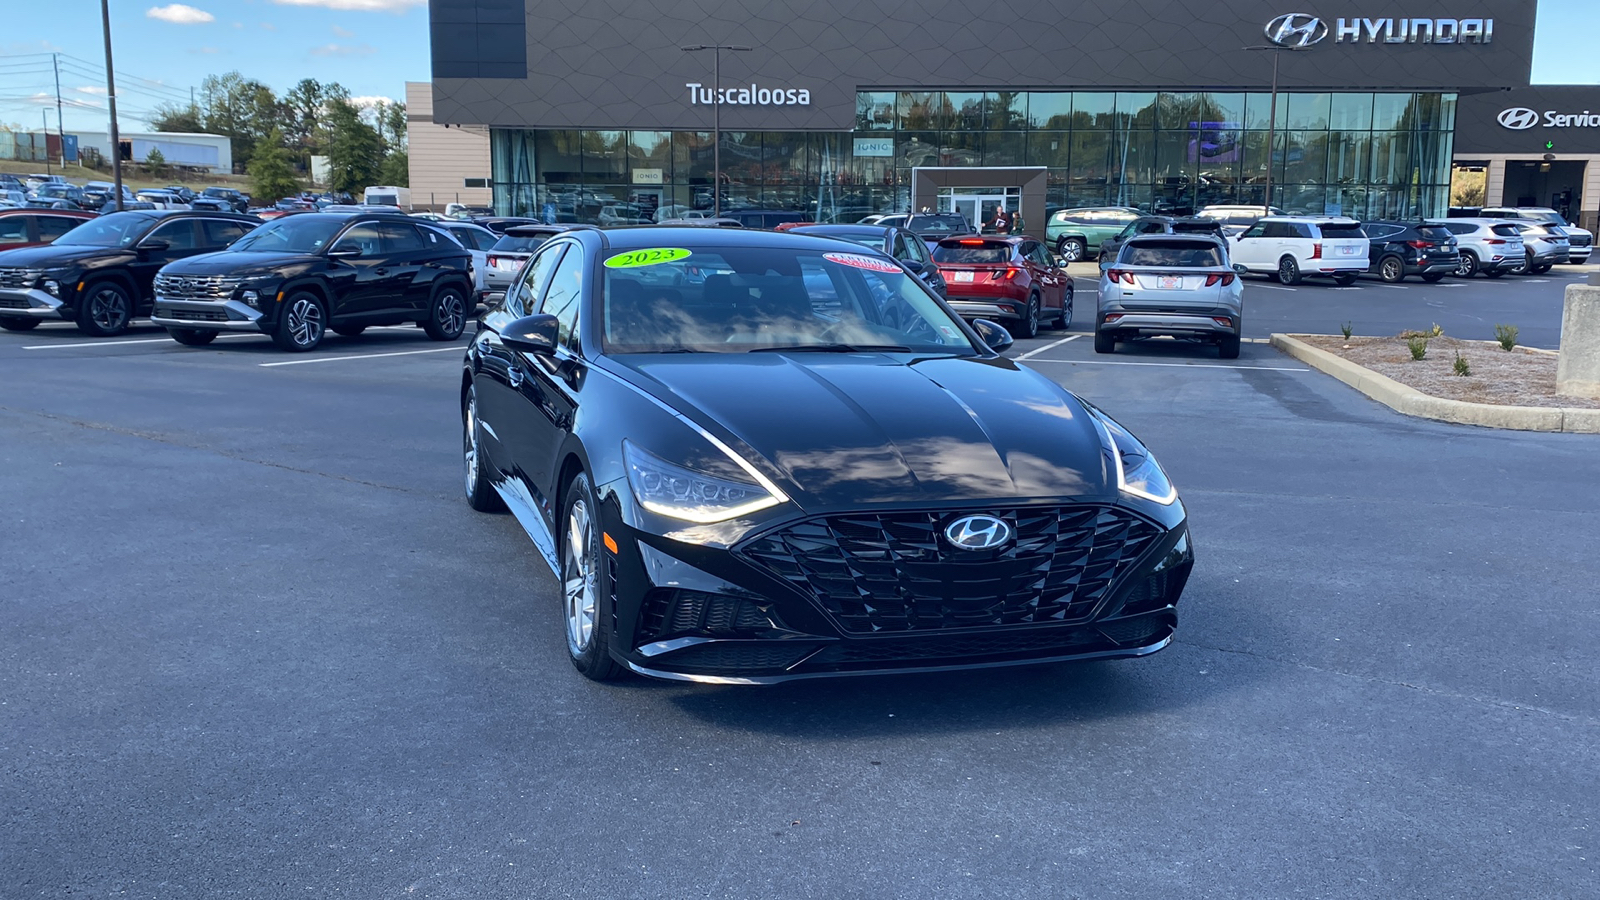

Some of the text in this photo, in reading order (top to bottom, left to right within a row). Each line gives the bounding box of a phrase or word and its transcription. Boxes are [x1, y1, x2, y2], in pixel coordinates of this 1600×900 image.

[1335, 18, 1493, 43] HYUNDAI
[685, 83, 810, 105] Tuscaloosa
[1542, 110, 1600, 127] Servic
[621, 249, 675, 266] 2023
